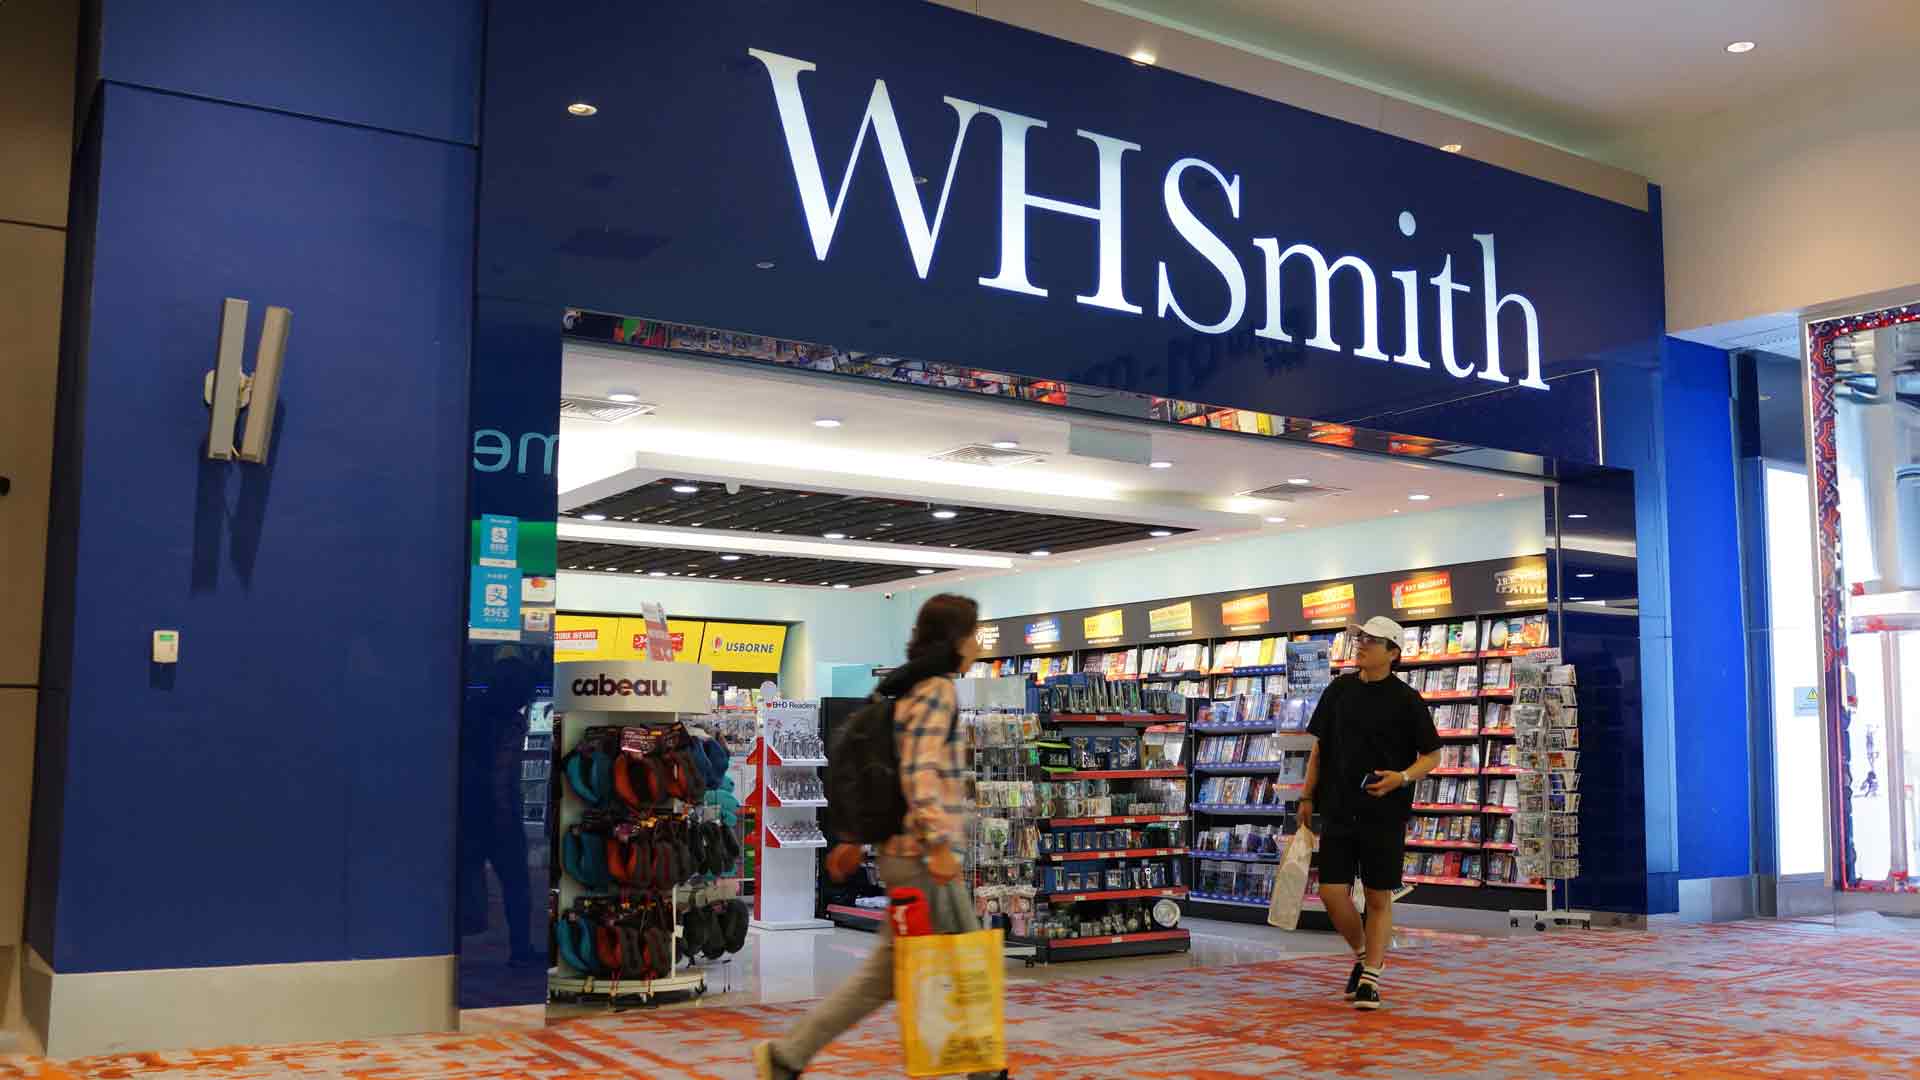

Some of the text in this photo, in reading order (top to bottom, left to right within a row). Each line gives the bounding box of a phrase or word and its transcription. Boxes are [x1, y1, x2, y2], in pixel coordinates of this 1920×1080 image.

[748, 48, 1550, 391] WHSmith
[726, 642, 775, 654] USBORNE
[571, 674, 667, 697] cabeau
